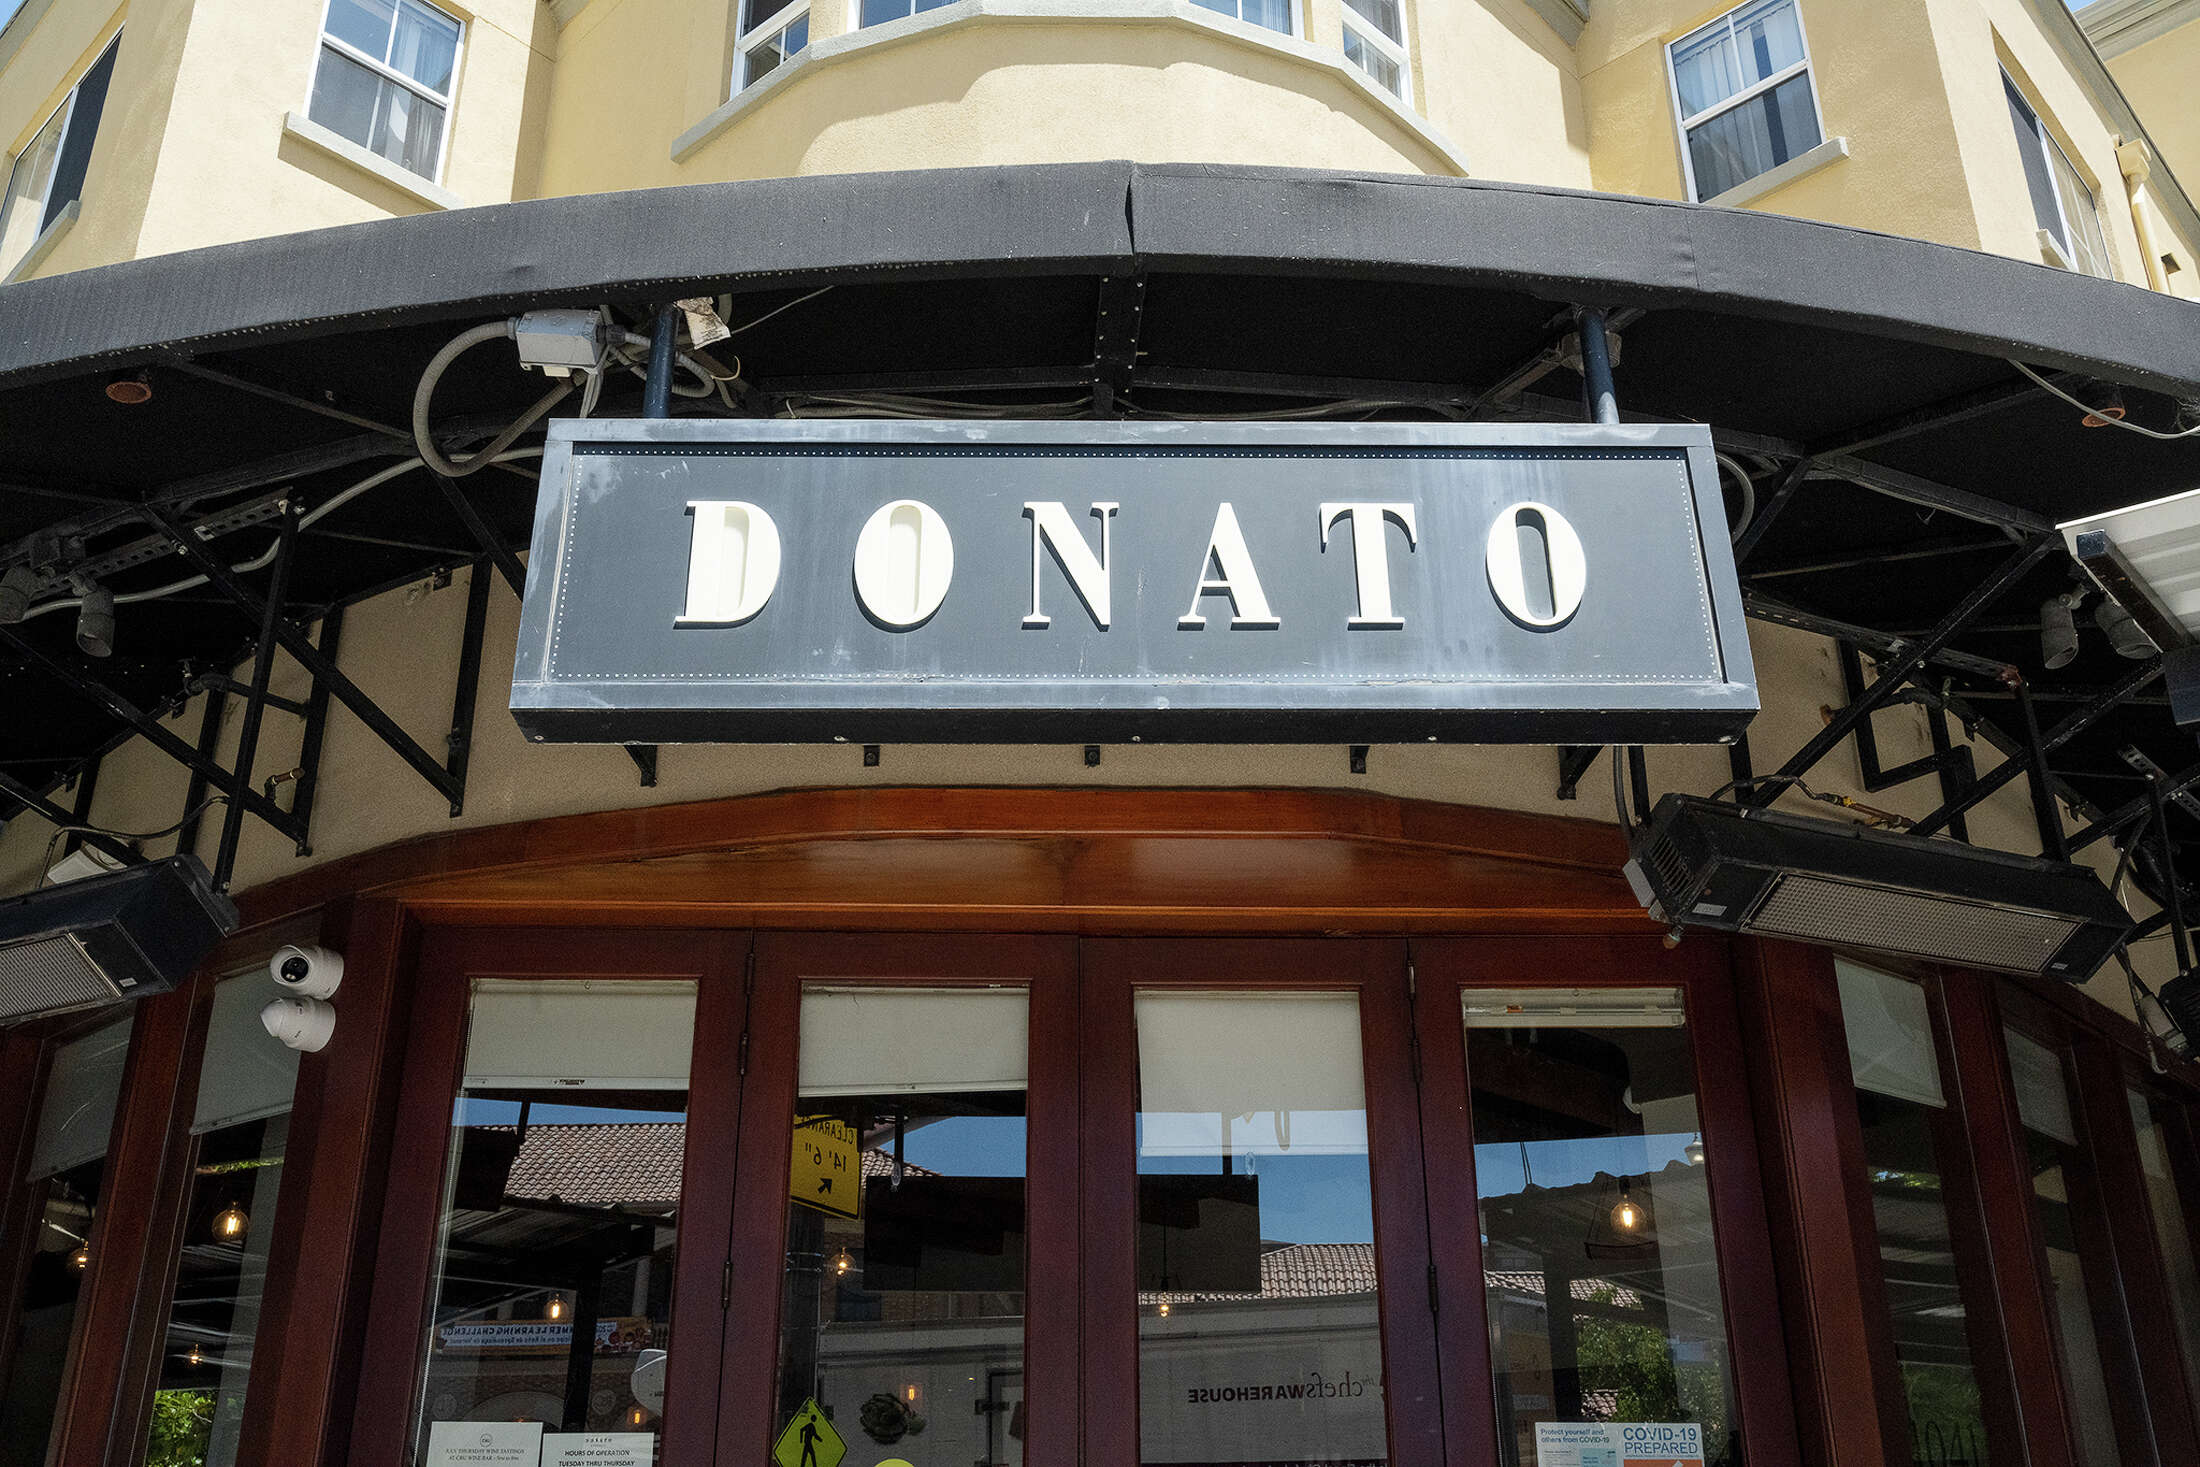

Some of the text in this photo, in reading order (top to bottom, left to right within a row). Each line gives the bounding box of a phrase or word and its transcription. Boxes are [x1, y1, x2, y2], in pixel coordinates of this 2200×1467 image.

[674, 499, 1587, 631] DONATO
[1564, 1428, 1590, 1437] yourself
[1623, 1426, 1697, 1441] COVID-19
[1579, 1436, 1609, 1444] COVID-19
[564, 1449, 586, 1457] HOURS
[1624, 1441, 1698, 1455] PREPARED
